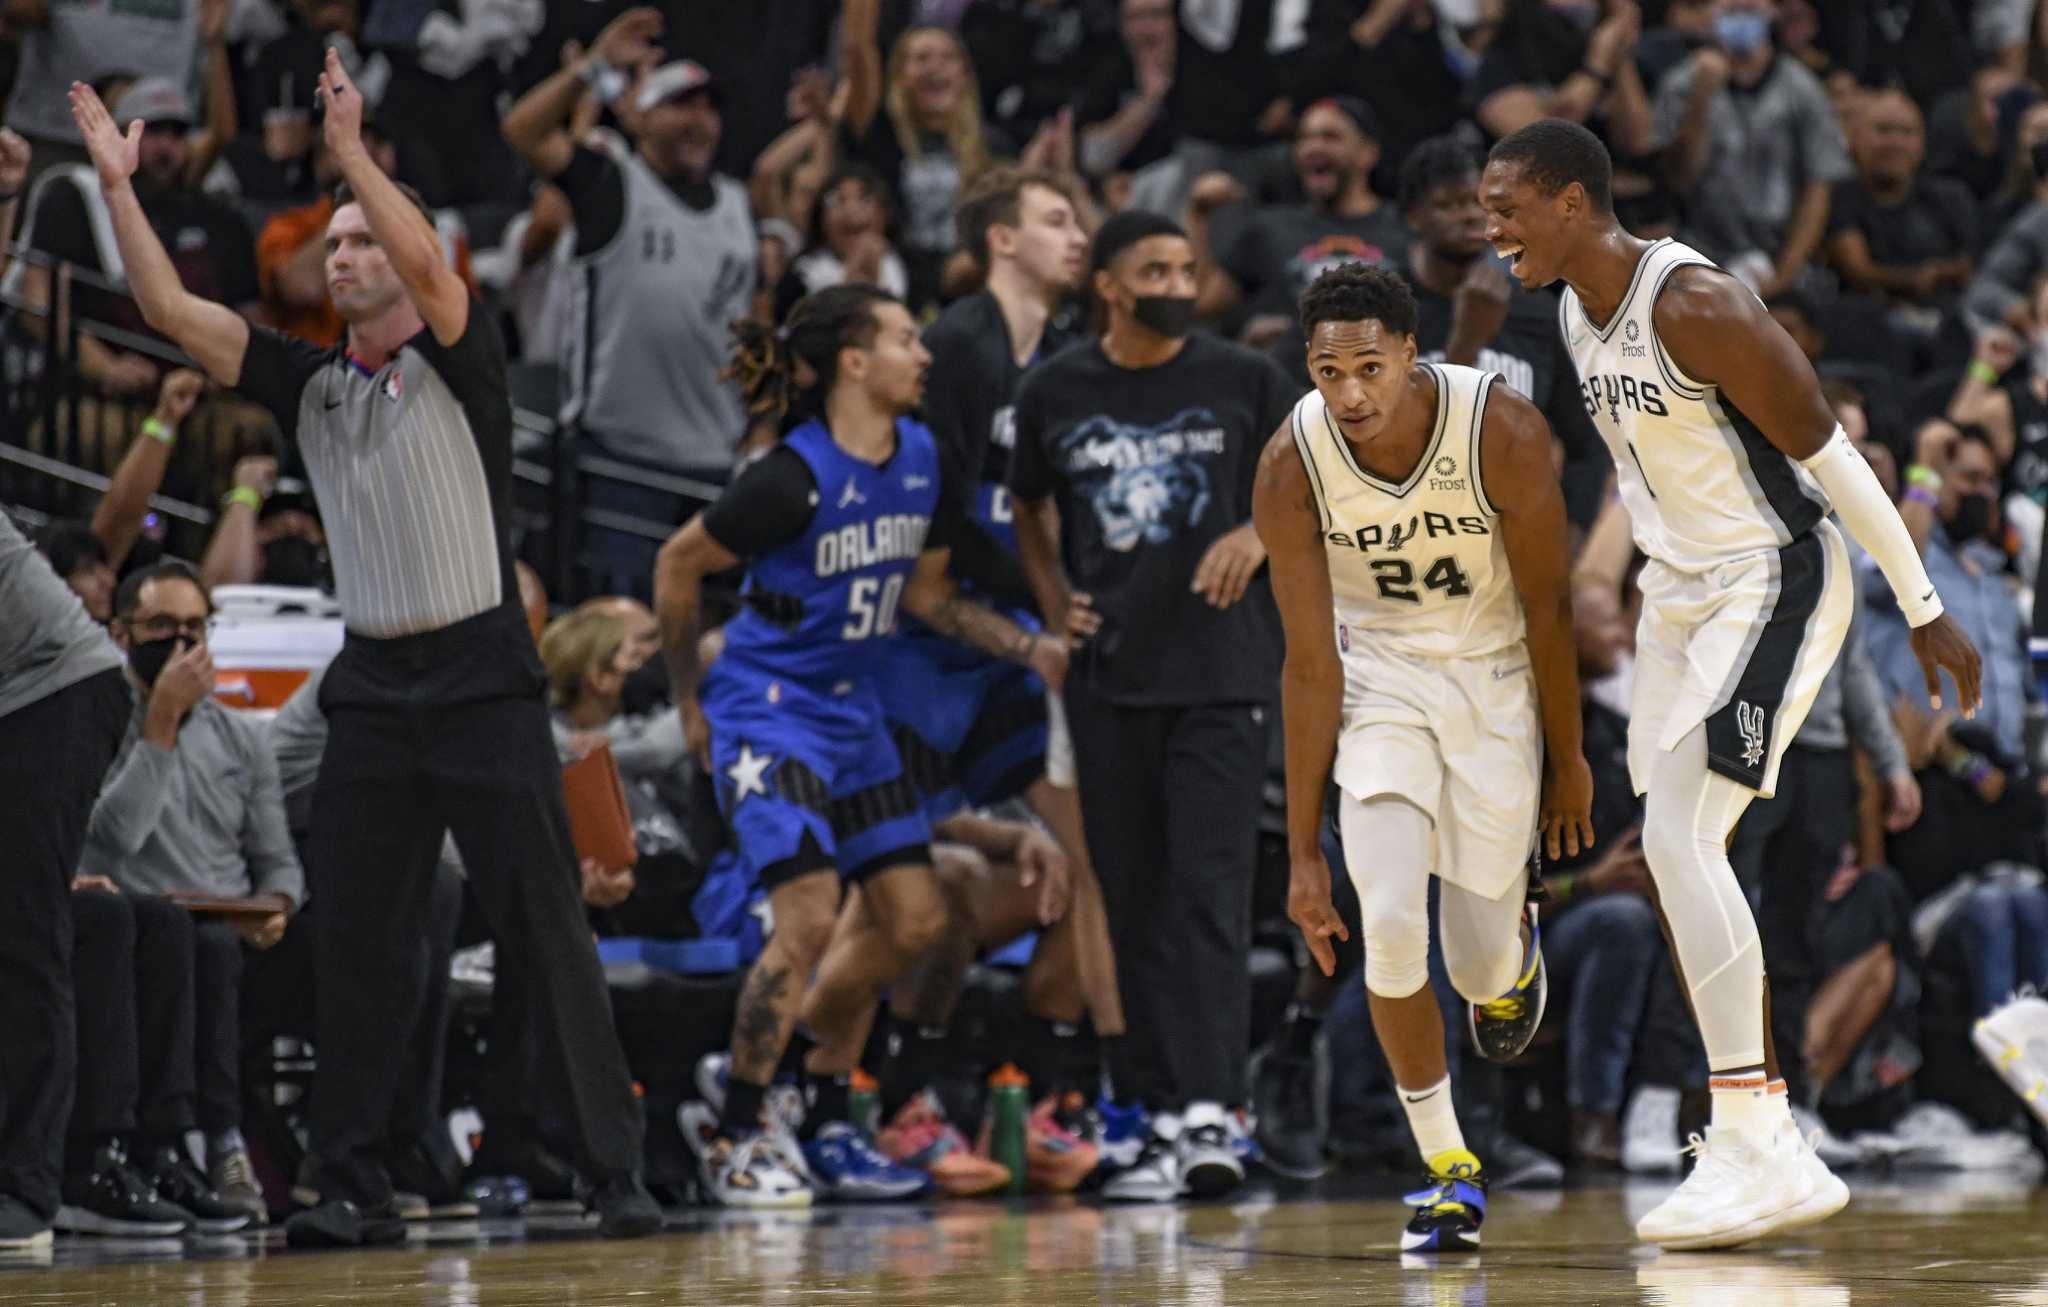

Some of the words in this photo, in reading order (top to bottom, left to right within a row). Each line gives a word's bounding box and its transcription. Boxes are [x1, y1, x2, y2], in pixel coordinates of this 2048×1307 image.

[1621, 342, 1646, 357] Frost
[1580, 374, 1669, 426] SPURS
[1429, 478, 1467, 491] Frost
[815, 513, 931, 577] ORLAND
[1328, 511, 1490, 552] SPURS
[1369, 553, 1473, 606] 24
[842, 572, 904, 640] 50
